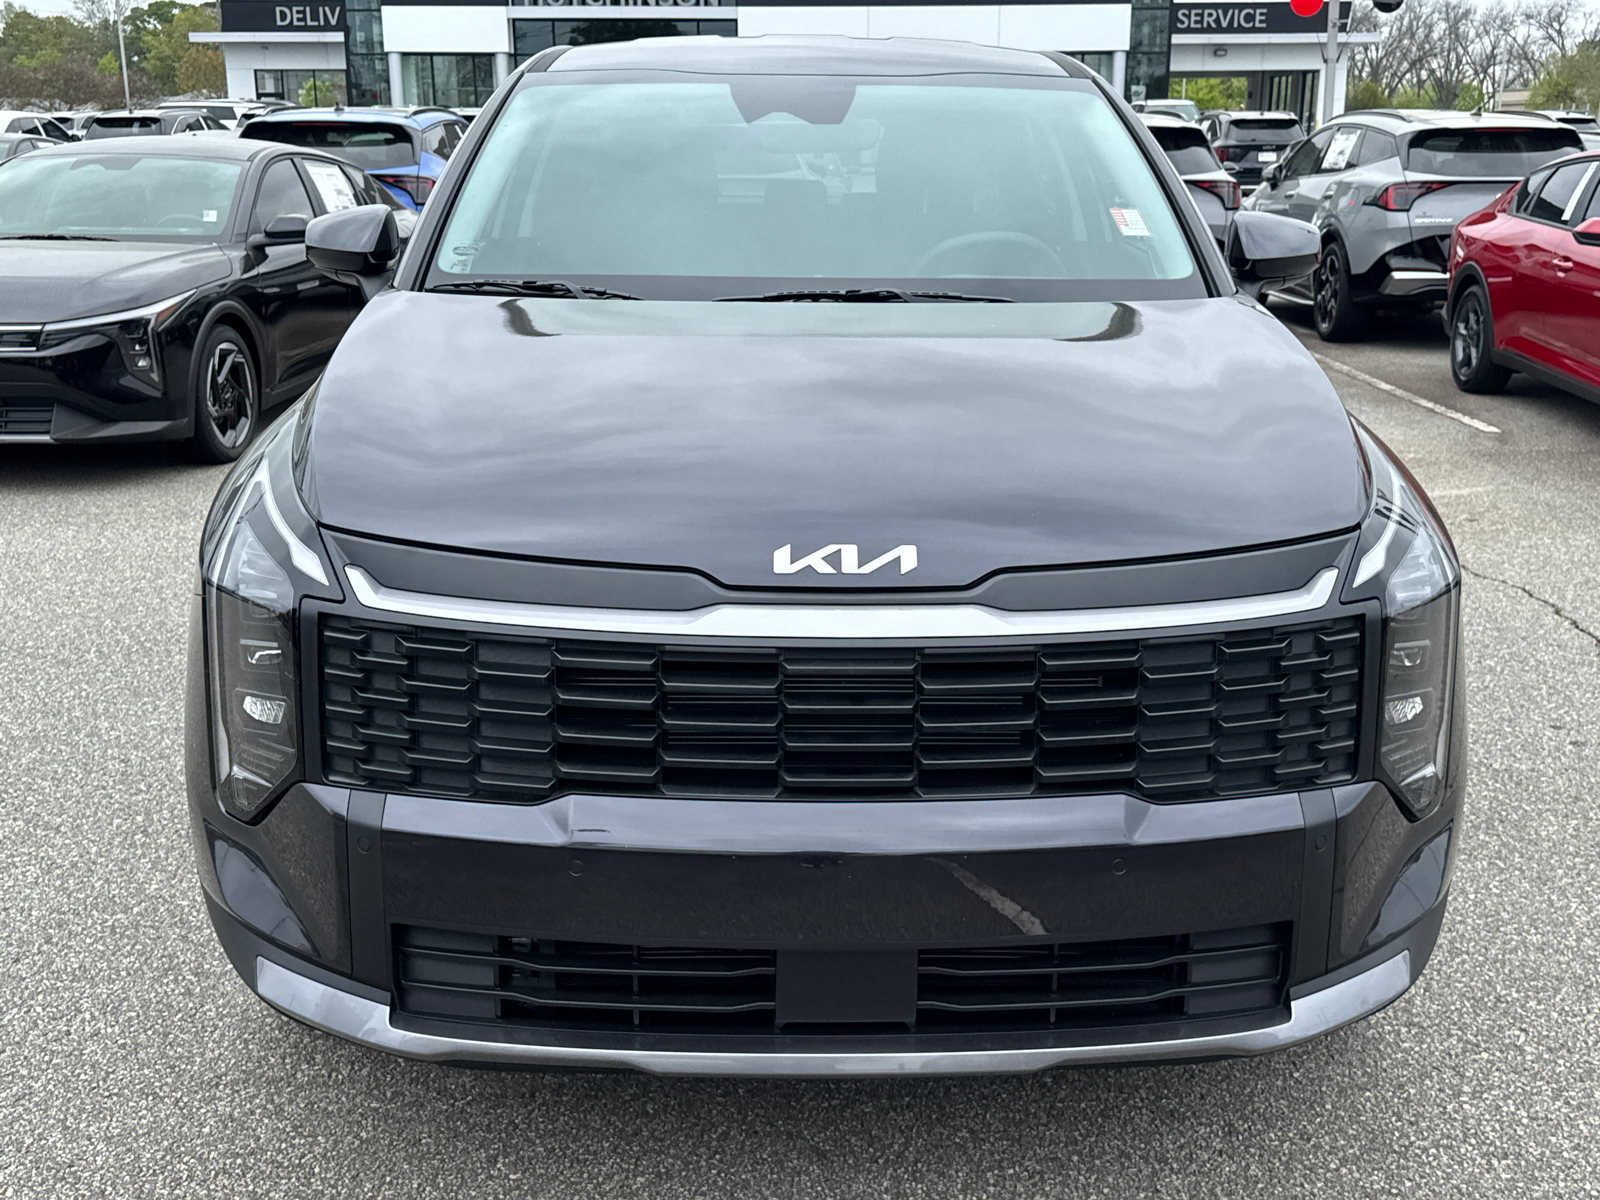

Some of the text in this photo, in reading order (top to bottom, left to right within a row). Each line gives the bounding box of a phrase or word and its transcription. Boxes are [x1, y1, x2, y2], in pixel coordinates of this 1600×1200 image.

[275, 6, 341, 26] DELIV
[1176, 8, 1268, 29] SERVICE
[773, 543, 918, 575] KIA
